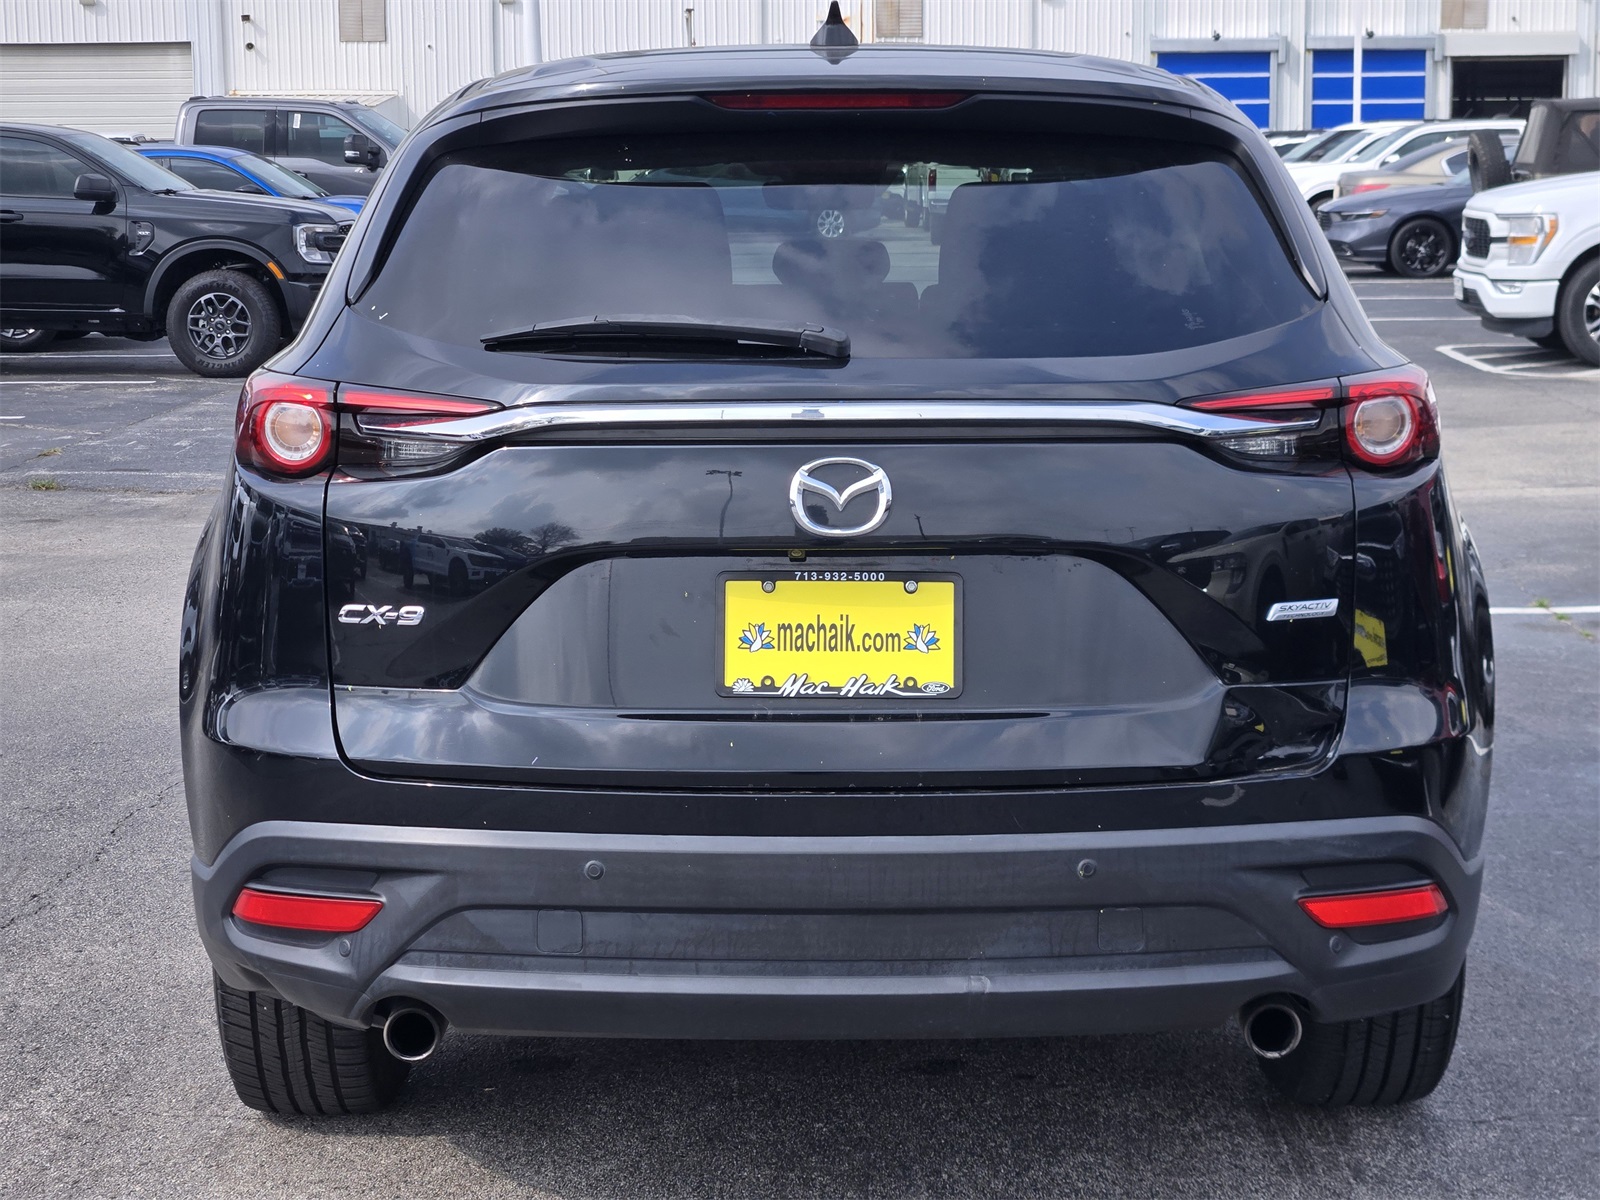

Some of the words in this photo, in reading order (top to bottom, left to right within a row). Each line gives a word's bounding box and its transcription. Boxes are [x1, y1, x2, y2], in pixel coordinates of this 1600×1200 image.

[794, 571, 886, 581] 713-932-5000
[338, 603, 425, 625] CX-9
[1278, 602, 1333, 612] SKYACTIV
[1282, 611, 1325, 619] TECHNOLOGY
[777, 614, 901, 652] machaik.com
[780, 673, 838, 697] Mac
[839, 673, 902, 697] Haik
